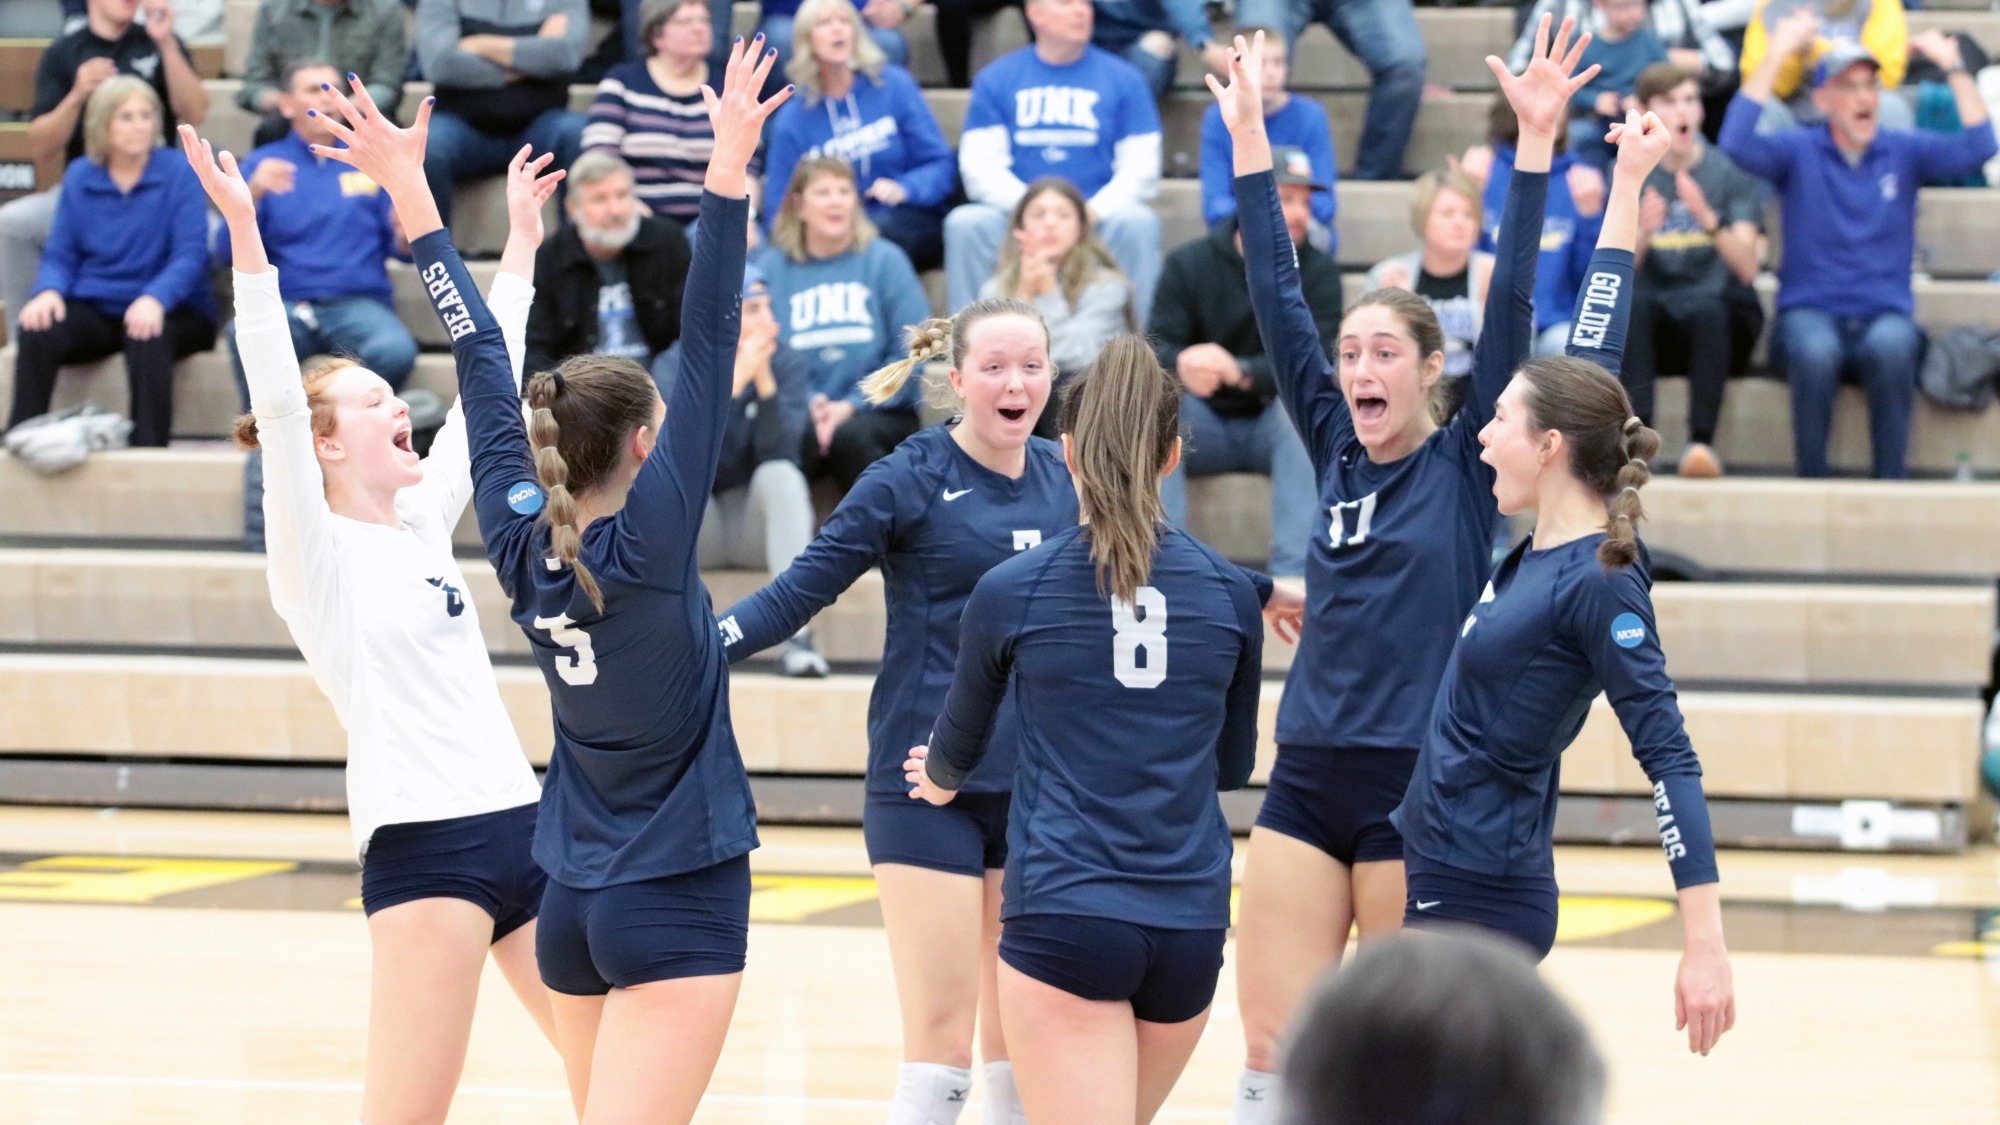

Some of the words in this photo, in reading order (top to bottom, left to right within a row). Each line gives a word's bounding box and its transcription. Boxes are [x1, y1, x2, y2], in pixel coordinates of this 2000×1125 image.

[1014, 85, 1101, 131] UNK
[422, 260, 477, 342] BEARS
[789, 282, 874, 332] UNK
[508, 486, 538, 504] NCAA
[1328, 491, 1377, 548] 17
[1110, 586, 1168, 689] 8
[1616, 628, 1644, 640] NCAA
